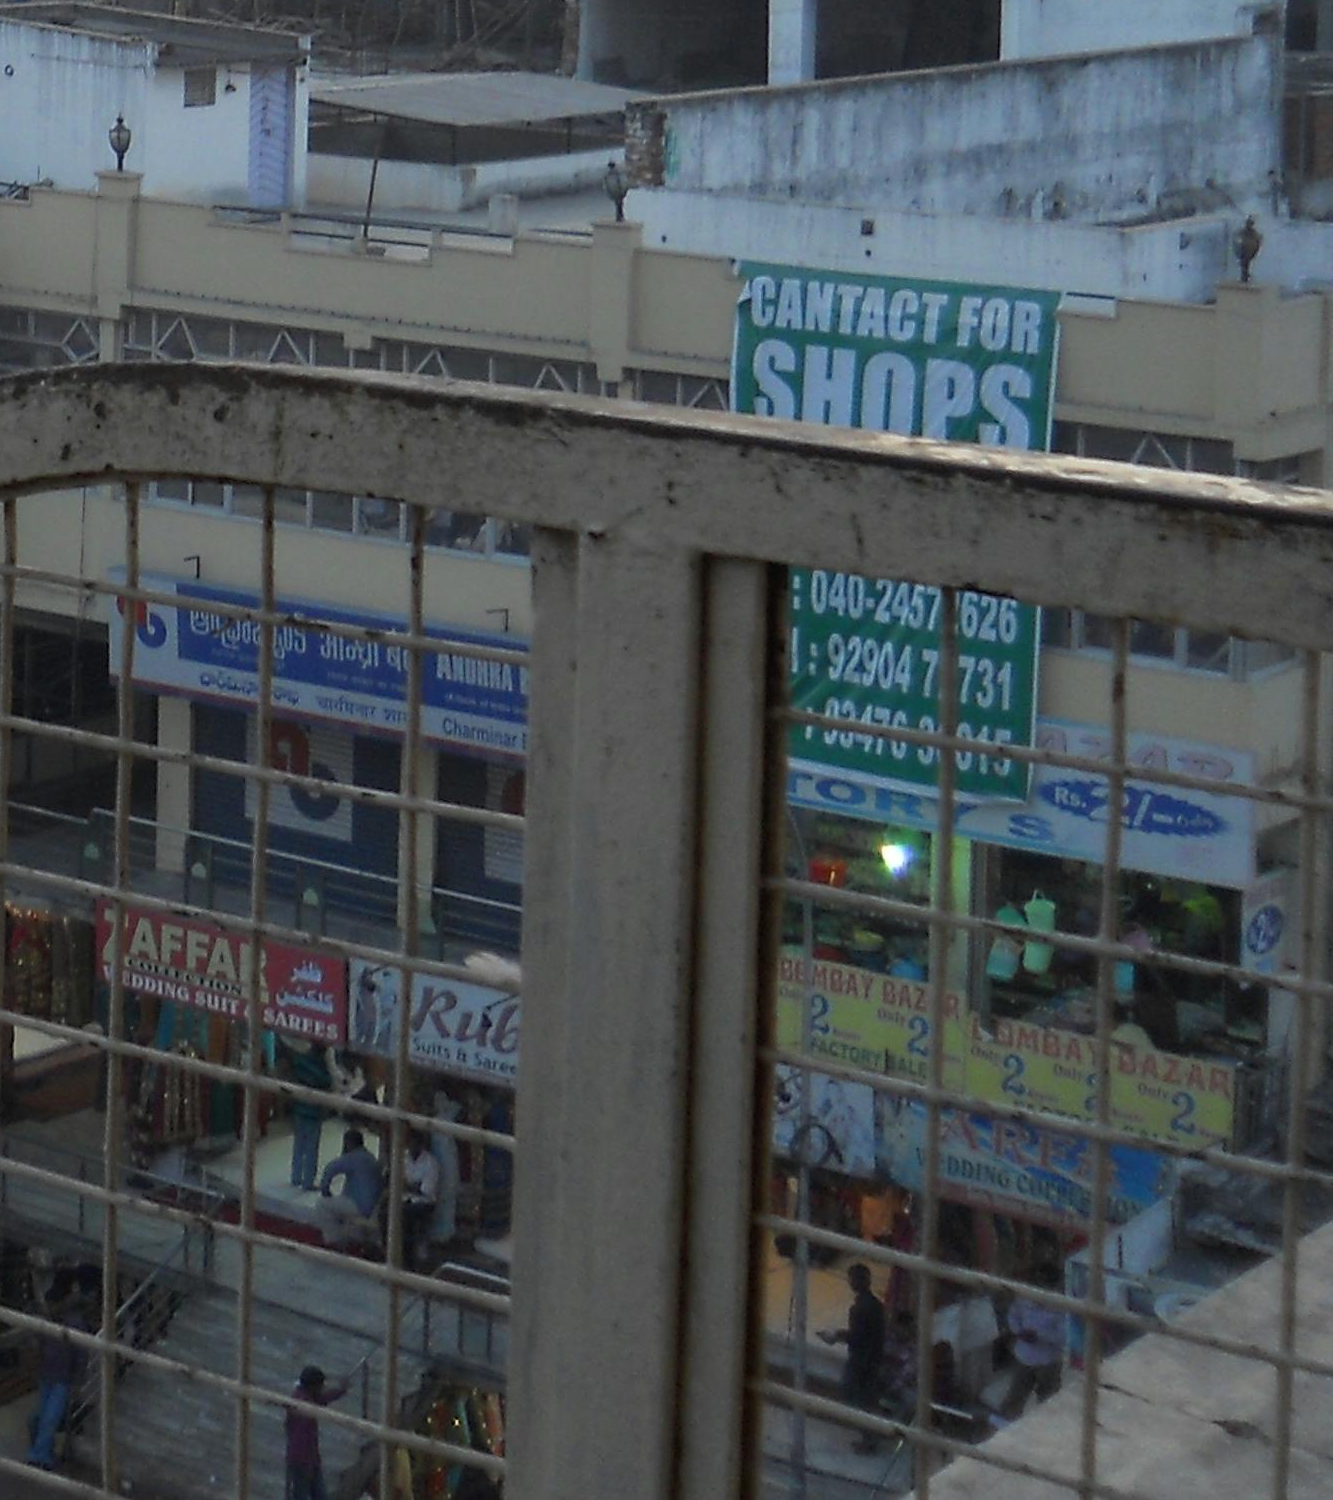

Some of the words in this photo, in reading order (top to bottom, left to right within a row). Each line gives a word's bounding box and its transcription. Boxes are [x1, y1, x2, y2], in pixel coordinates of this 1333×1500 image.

[751, 275, 949, 343] CANTACT
[957, 297, 1040, 355] FOR
[753, 339, 1031, 452] SHOPS
[811, 570, 1018, 645] 040-2457626
[436, 651, 513, 692] ANDHRA
[827, 633, 912, 693] 92904
[921, 649, 1011, 711] 7731
[443, 717, 517, 748] Charminar
[1055, 785, 1088, 809] Rs.
[195, 991, 240, 1015] SUIT
[264, 1008, 338, 1040] SAREES
[884, 981, 959, 1019] BAZR
[413, 1037, 451, 1061] Suits
[907, 1016, 930, 1057] 2
[1001, 1054, 1027, 1097] 2
[1117, 1047, 1232, 1098] BAZAR
[1169, 1091, 1197, 1135] 2
